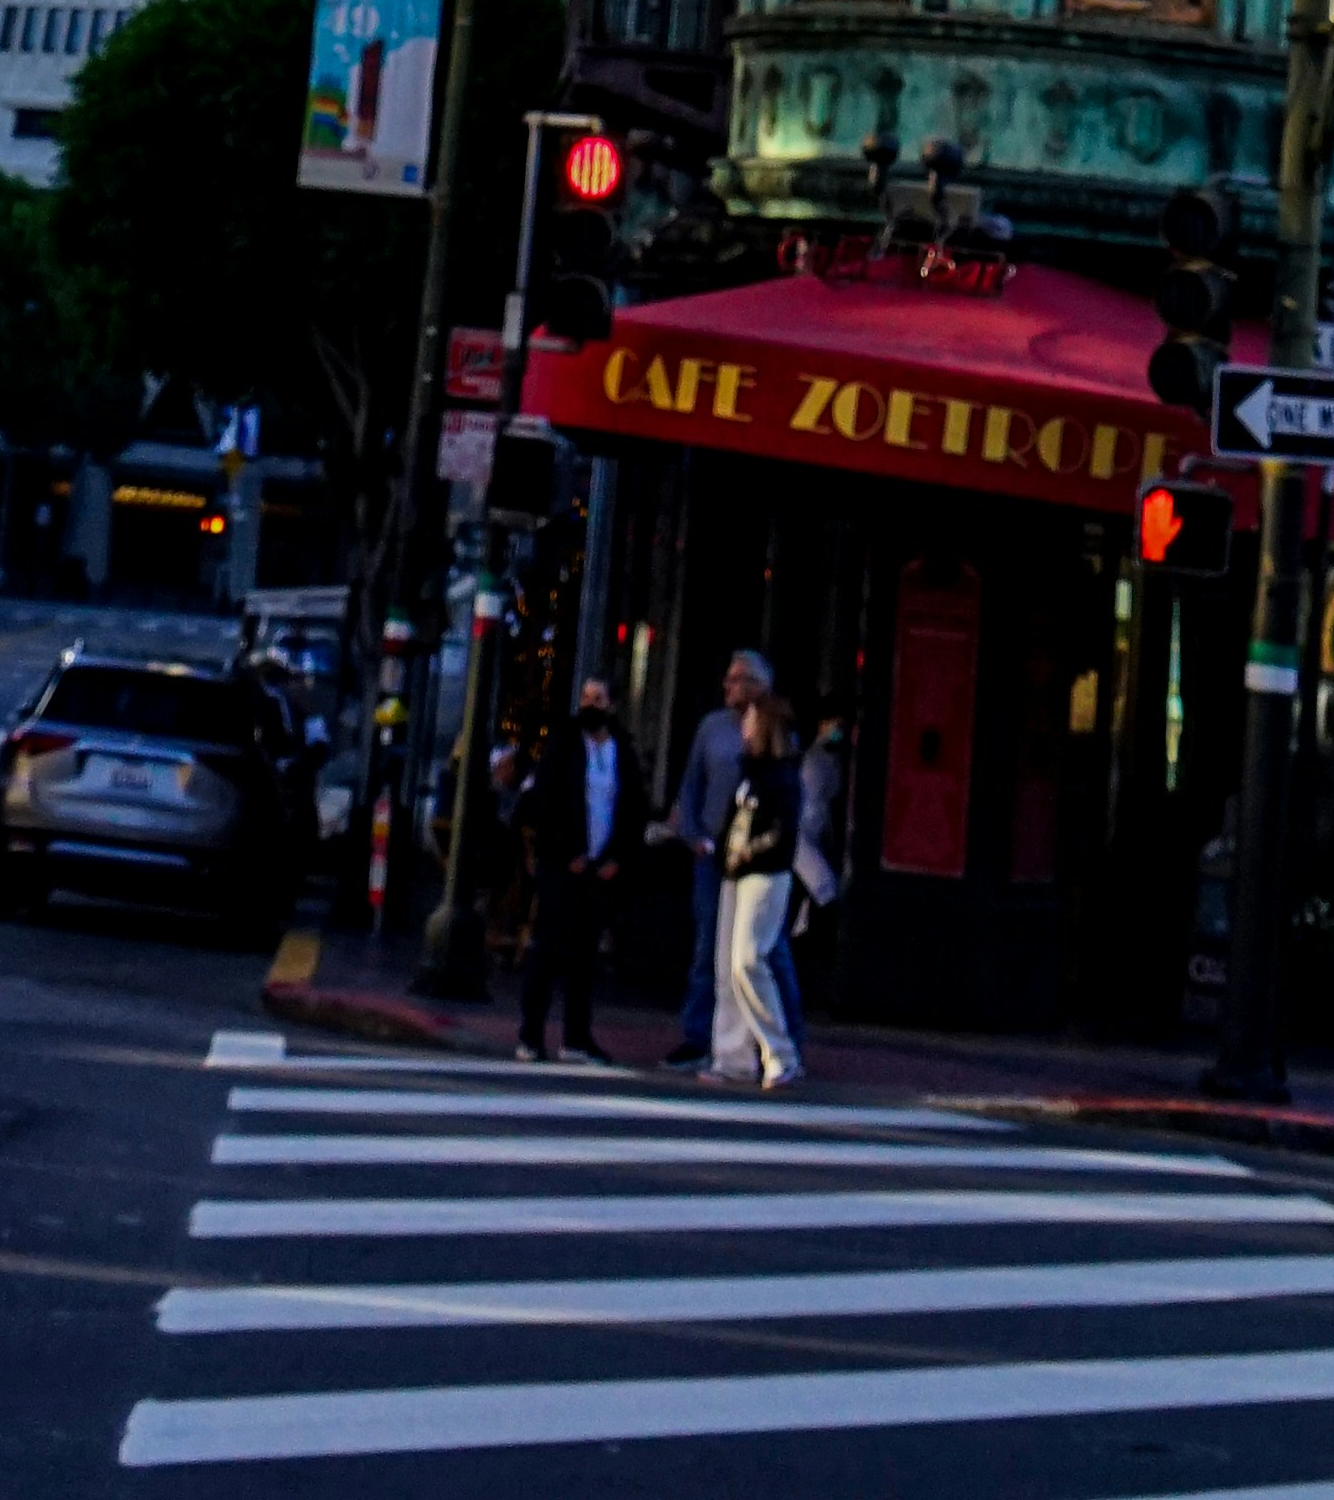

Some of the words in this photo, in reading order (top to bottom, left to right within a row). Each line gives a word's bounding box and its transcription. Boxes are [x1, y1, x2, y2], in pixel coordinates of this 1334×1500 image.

[603, 346, 758, 424] CAFE
[789, 373, 1181, 483] ZOETROPE
[1267, 400, 1305, 431] ONE
